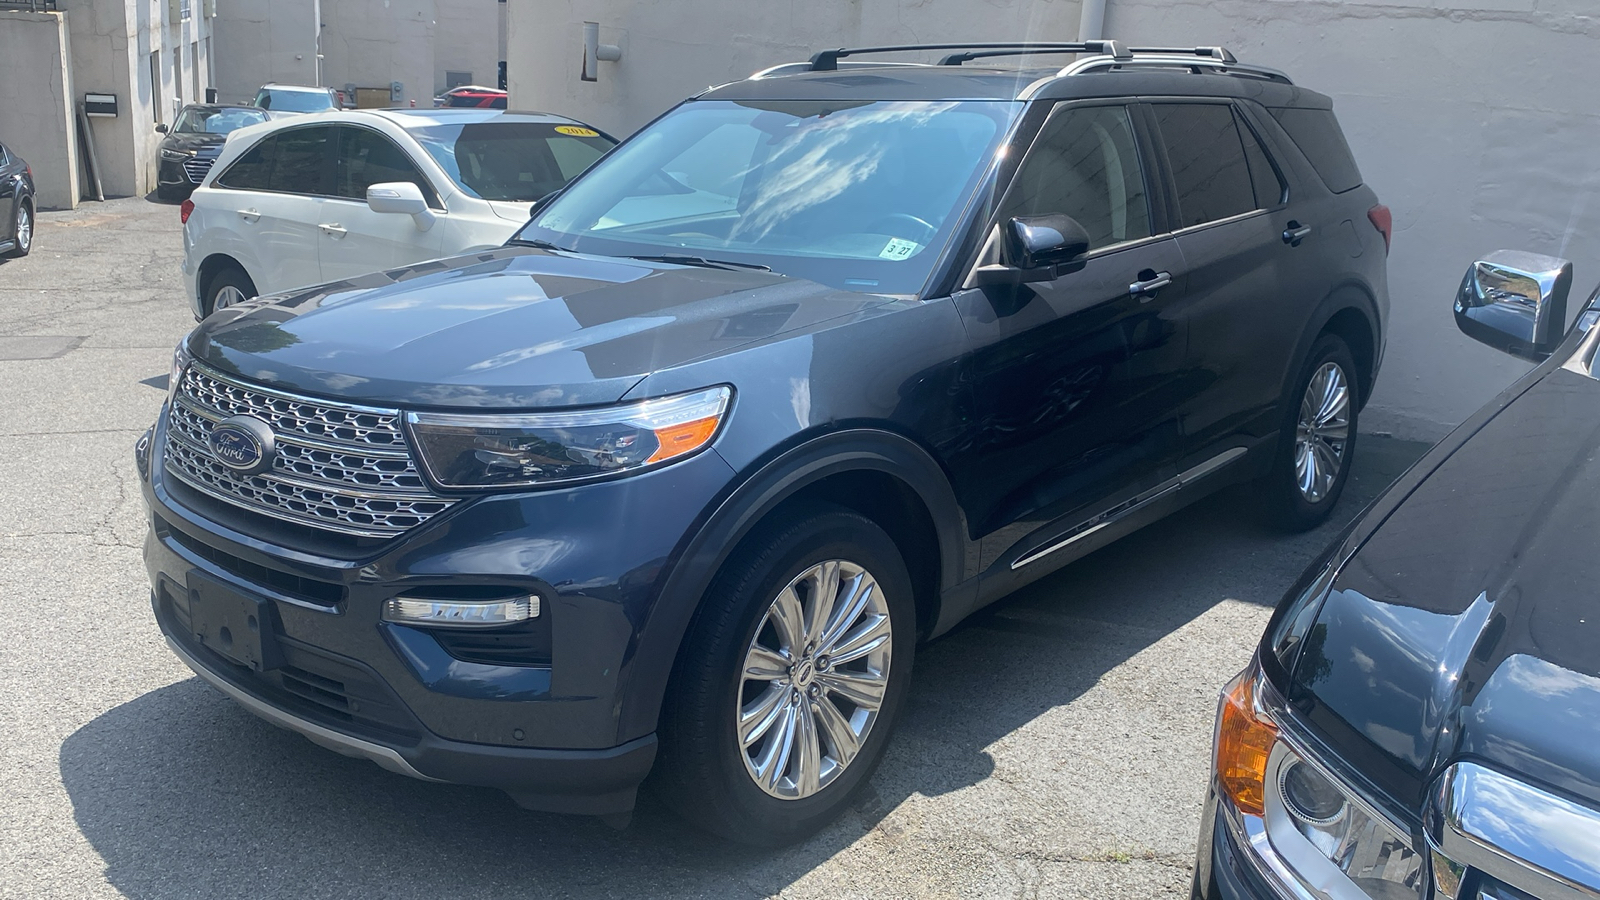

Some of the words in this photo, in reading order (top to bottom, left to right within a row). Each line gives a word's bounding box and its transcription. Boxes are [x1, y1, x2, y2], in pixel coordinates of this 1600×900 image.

[563, 127, 592, 135] 2014
[887, 244, 897, 253] 3
[897, 246, 911, 256] 27
[215, 432, 248, 461] Ford
